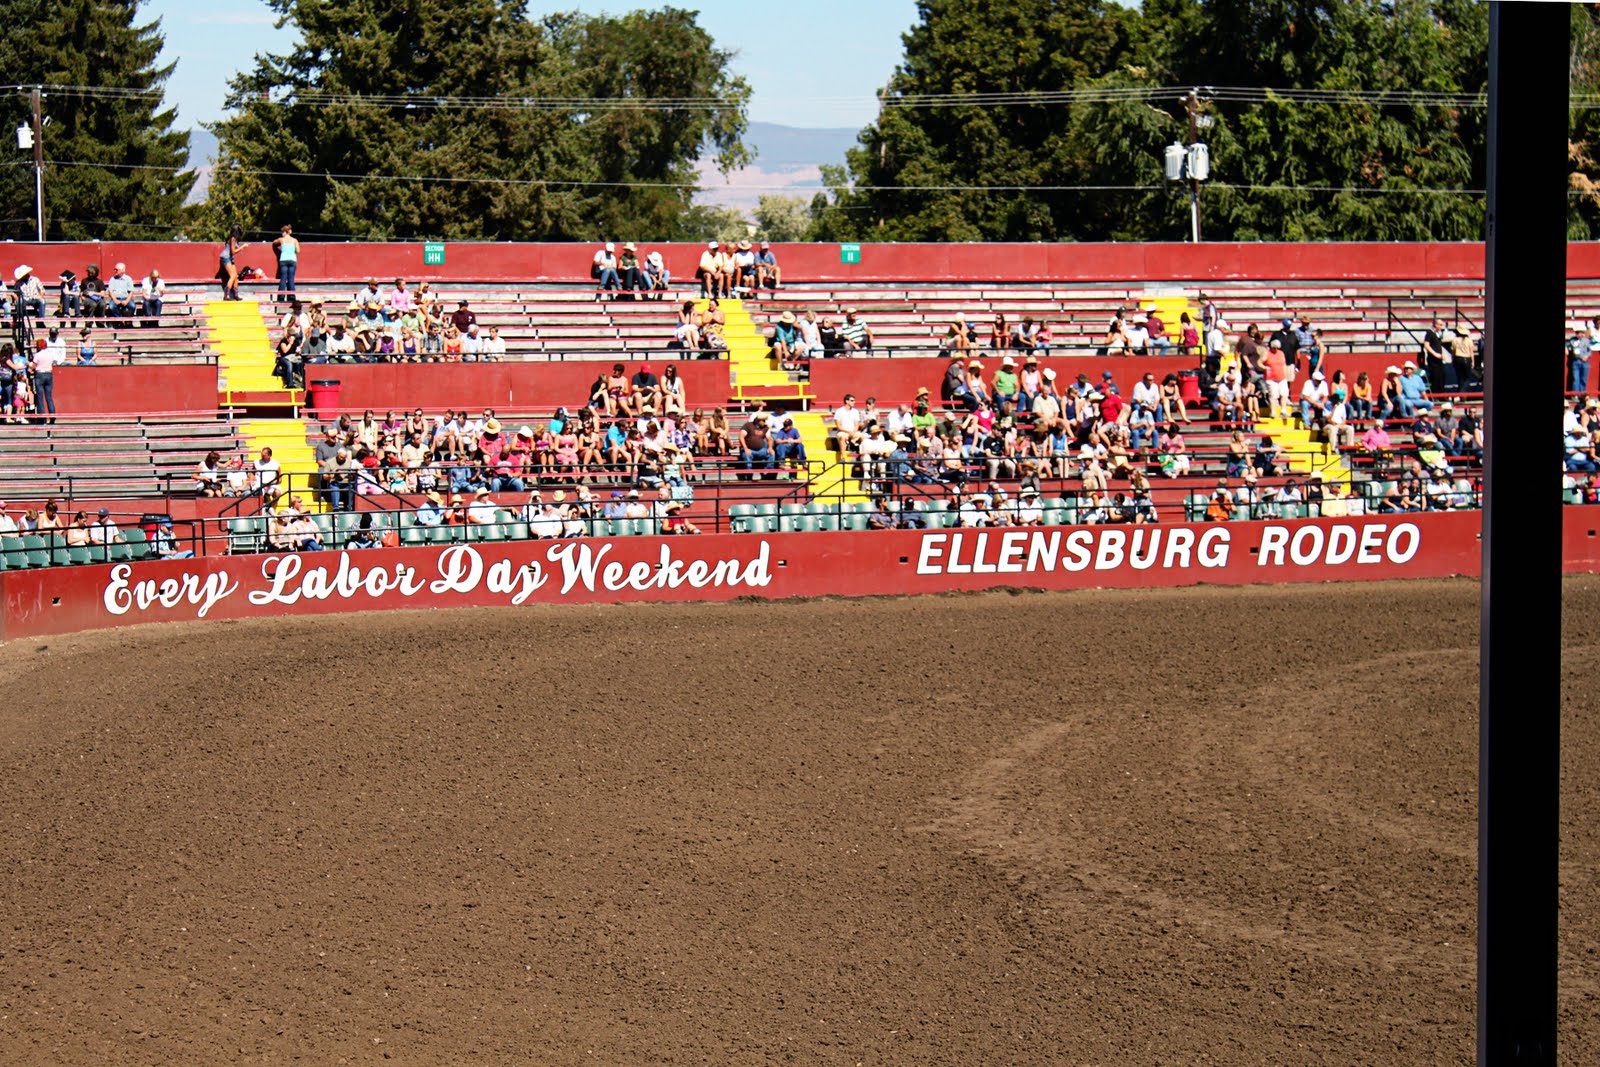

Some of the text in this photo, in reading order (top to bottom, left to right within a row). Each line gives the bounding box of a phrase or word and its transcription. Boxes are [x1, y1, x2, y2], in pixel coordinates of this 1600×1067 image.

[428, 252, 441, 263] HH
[916, 523, 1421, 575] ELLENSBURG RODEO
[103, 540, 773, 618] Every Labor Day Weekend
